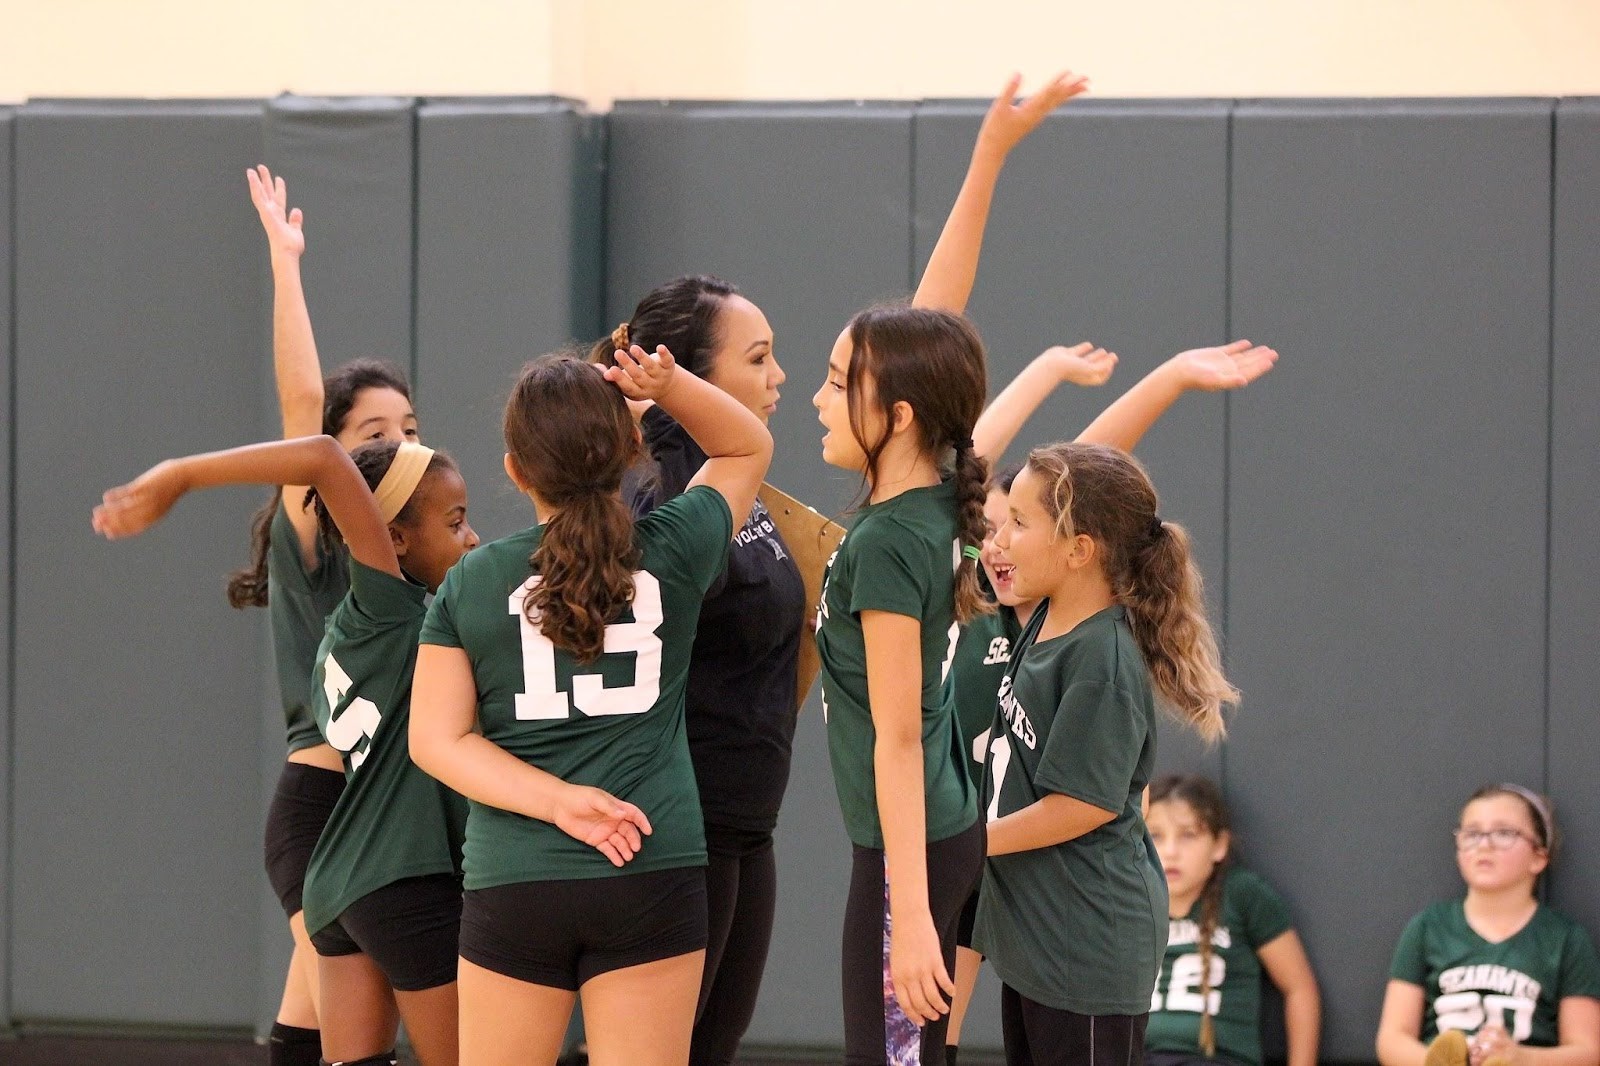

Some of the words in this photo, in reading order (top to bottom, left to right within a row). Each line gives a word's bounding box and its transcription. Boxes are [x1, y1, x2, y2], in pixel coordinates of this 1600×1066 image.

[508, 569, 664, 721] 13
[1149, 952, 1226, 1016] 2
[1438, 964, 1542, 1001] SEAHAWKS
